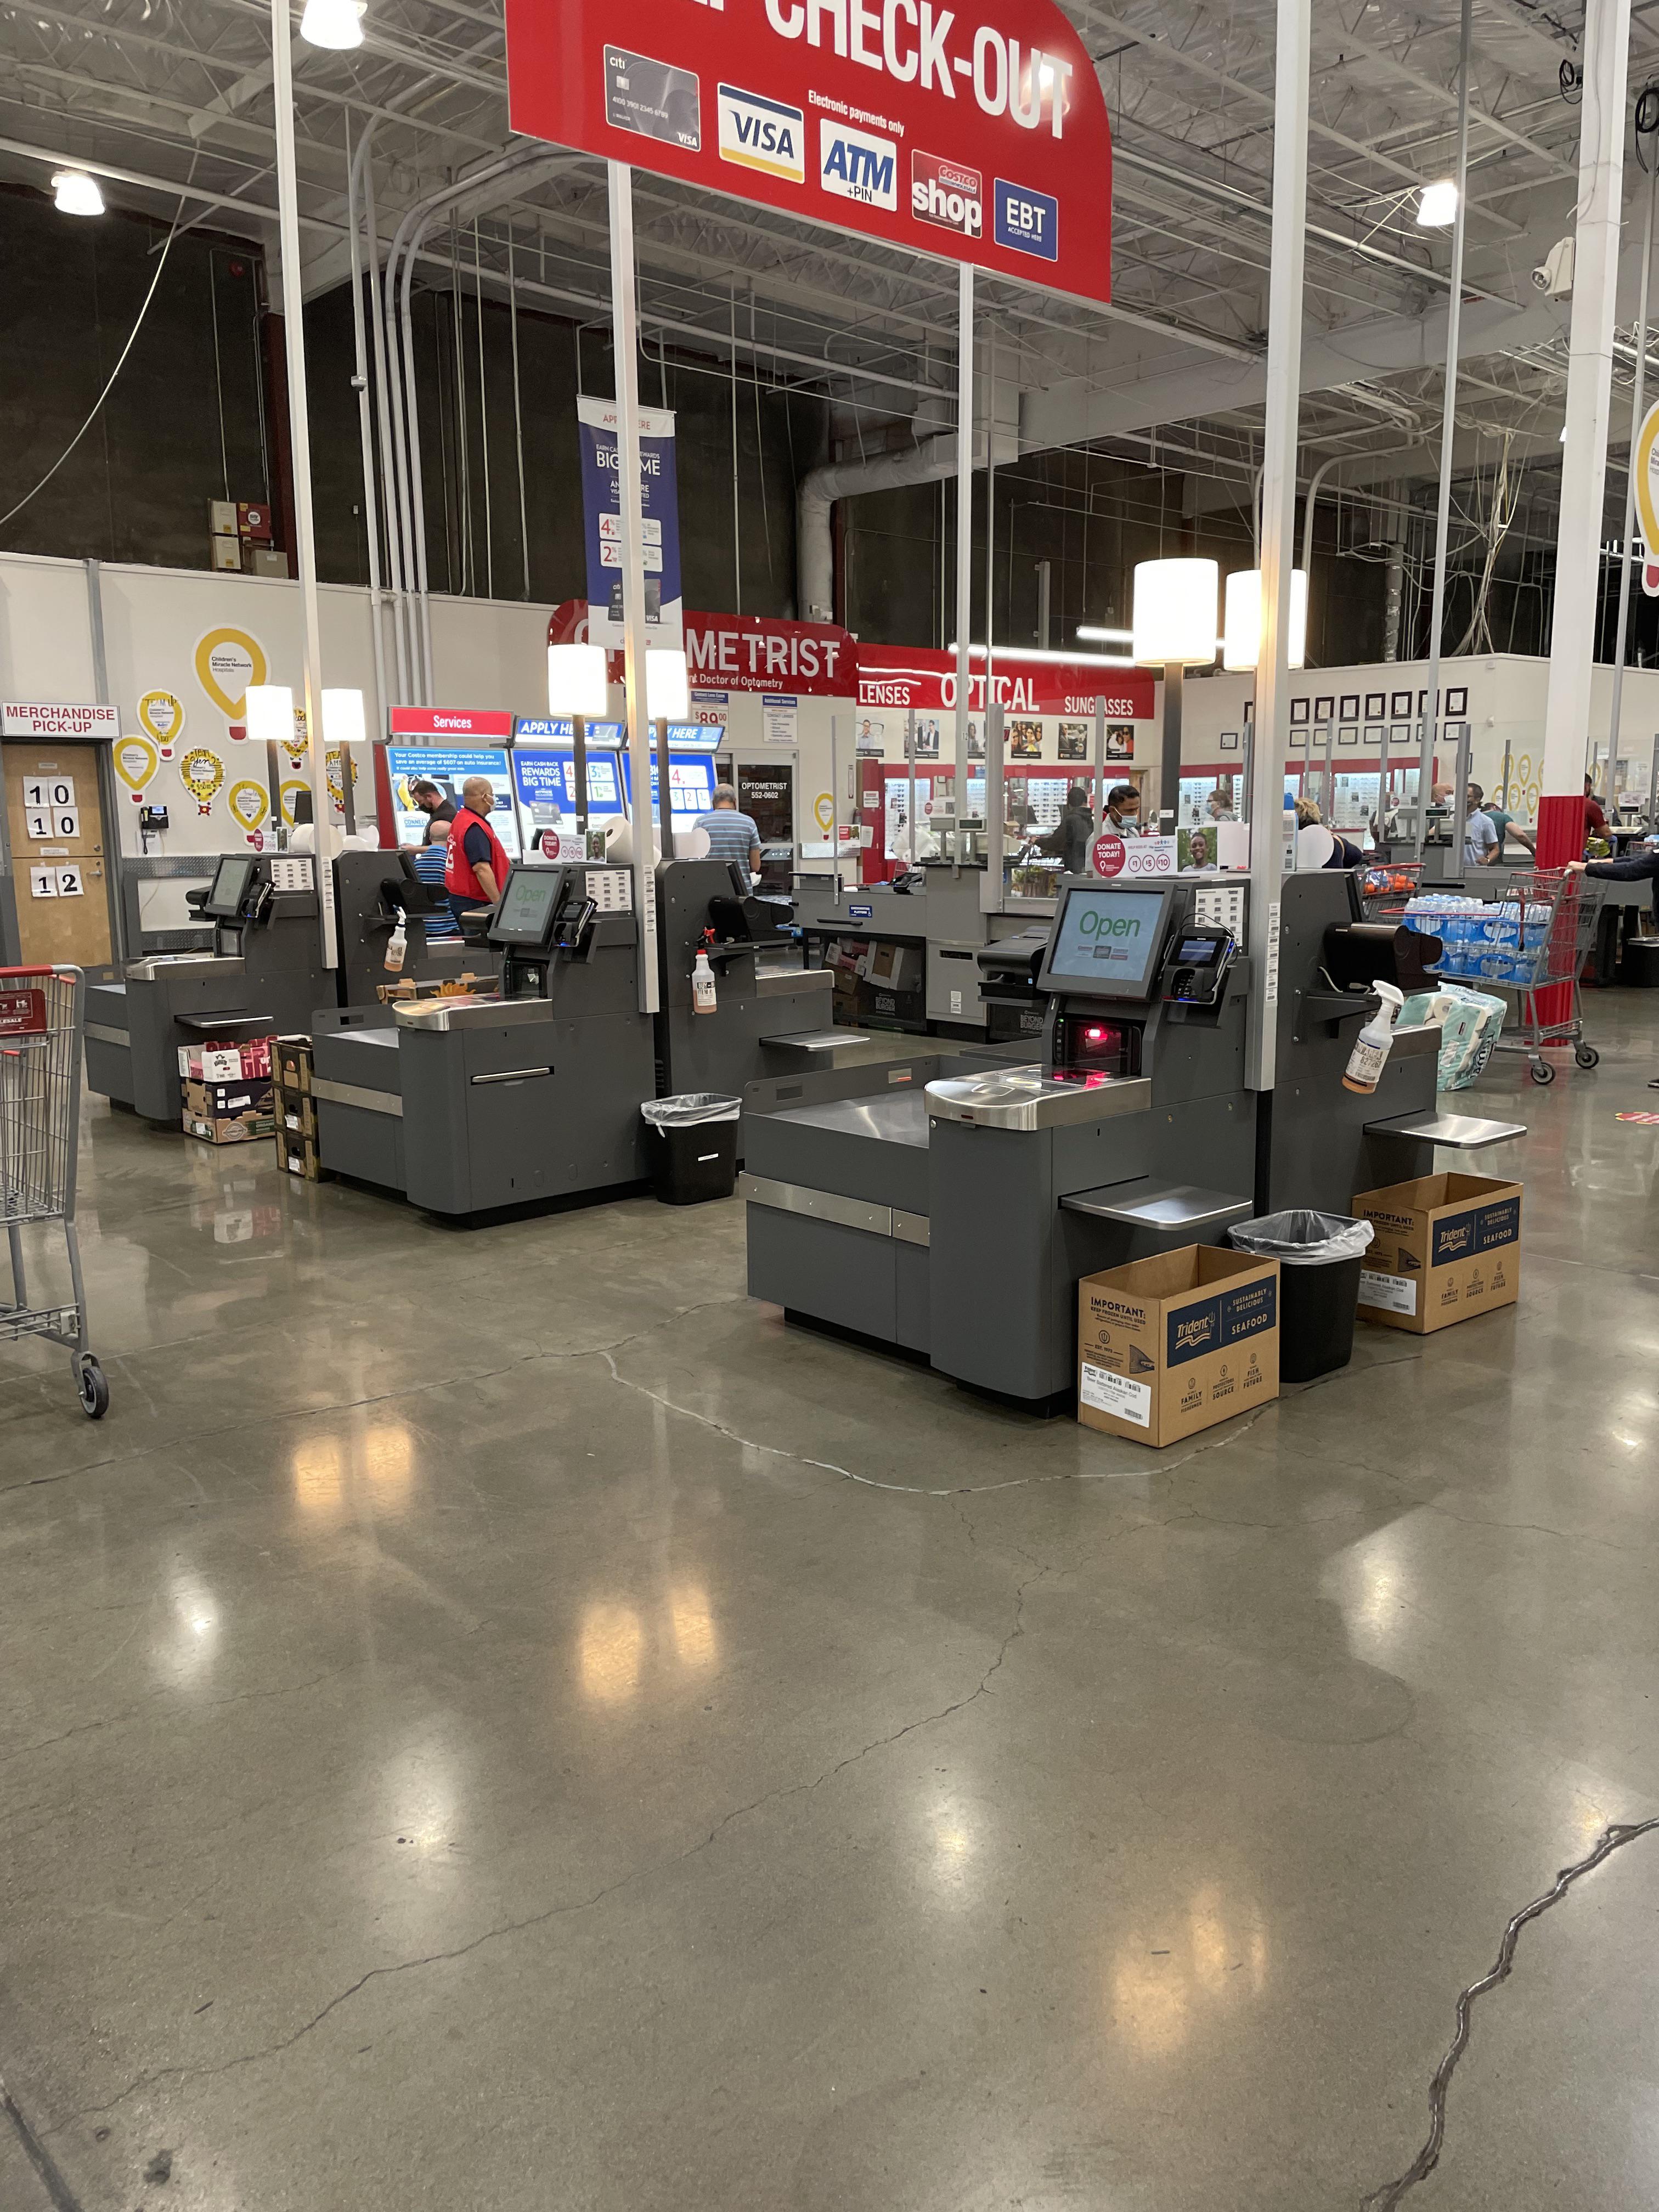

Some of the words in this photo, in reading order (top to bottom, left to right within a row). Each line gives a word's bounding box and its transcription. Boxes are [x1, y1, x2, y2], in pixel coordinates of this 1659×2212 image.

[765, 0, 1072, 139] CHECK-OUT
[808, 89, 848, 115] Electronic
[849, 106, 887, 129] payments
[888, 120, 905, 137] only
[676, 132, 697, 147] VISA
[729, 110, 794, 159] VISA
[823, 139, 894, 194] ATM
[939, 165, 977, 188] COSTCO
[847, 185, 872, 202] +PIN
[912, 179, 982, 235] shop
[1007, 197, 1046, 234] EBT
[1007, 227, 1030, 239] ACCEPTED
[1031, 232, 1042, 242] HERE
[596, 444, 610, 452] EARN
[640, 451, 661, 459] EWARDS
[596, 451, 619, 470] BIG
[640, 459, 661, 476] ME
[699, 674, 729, 685] Doctor
[730, 675, 740, 686] of
[741, 676, 783, 690] Optometry
[859, 684, 911, 706] LENSES
[6, 706, 115, 720] MERCHANDISE
[1064, 696, 1133, 716] SUNGASSES
[33, 720, 92, 732] PICK-UP
[433, 715, 472, 729] Services
[521, 721, 559, 735] APPLY
[560, 723, 590, 736] HEE
[672, 728, 698, 739] HERE
[329, 751, 341, 761] TEA
[522, 767, 560, 776] REWARDS
[523, 777, 537, 786] BIG
[538, 777, 562, 786] TIME
[1097, 842, 1121, 850] DONATE
[1098, 850, 1120, 859] TODAY!
[516, 885, 546, 905] Open
[1080, 911, 1141, 941] Open
[875, 996, 895, 1005] BEYOND
[876, 1002, 895, 1012] BURGER
[1020, 1015, 1043, 1024] BEYOND
[1363, 1210, 1414, 1226] IMPORTANT:
[1485, 1207, 1513, 1220] SUSTAINABLY
[1487, 1214, 1509, 1226] DELICIOUS
[1441, 1226, 1466, 1243] Trident
[1483, 1229, 1512, 1244] SEAFOOD
[1233, 1288, 1267, 1306] SUSTAINABLY
[1441, 1289, 1459, 1299] FAMILY
[1466, 1287, 1483, 1299] SOURCE
[1091, 1296, 1146, 1319] IMPORTANT:
[1235, 1296, 1263, 1312] DELICIOUS
[1102, 1307, 1120, 1318] FROZEN
[1120, 1314, 1133, 1322] UNTIL
[1177, 1316, 1209, 1338] Trident
[1231, 1313, 1268, 1335] SEAFOOD
[1247, 1367, 1260, 1377] FISH
[1243, 1375, 1262, 1389] FUTURE
[1181, 1391, 1203, 1405] FAMILY
[1212, 1386, 1234, 1400] SOURCE
[1181, 1402, 1202, 1413] FISHERMEN
